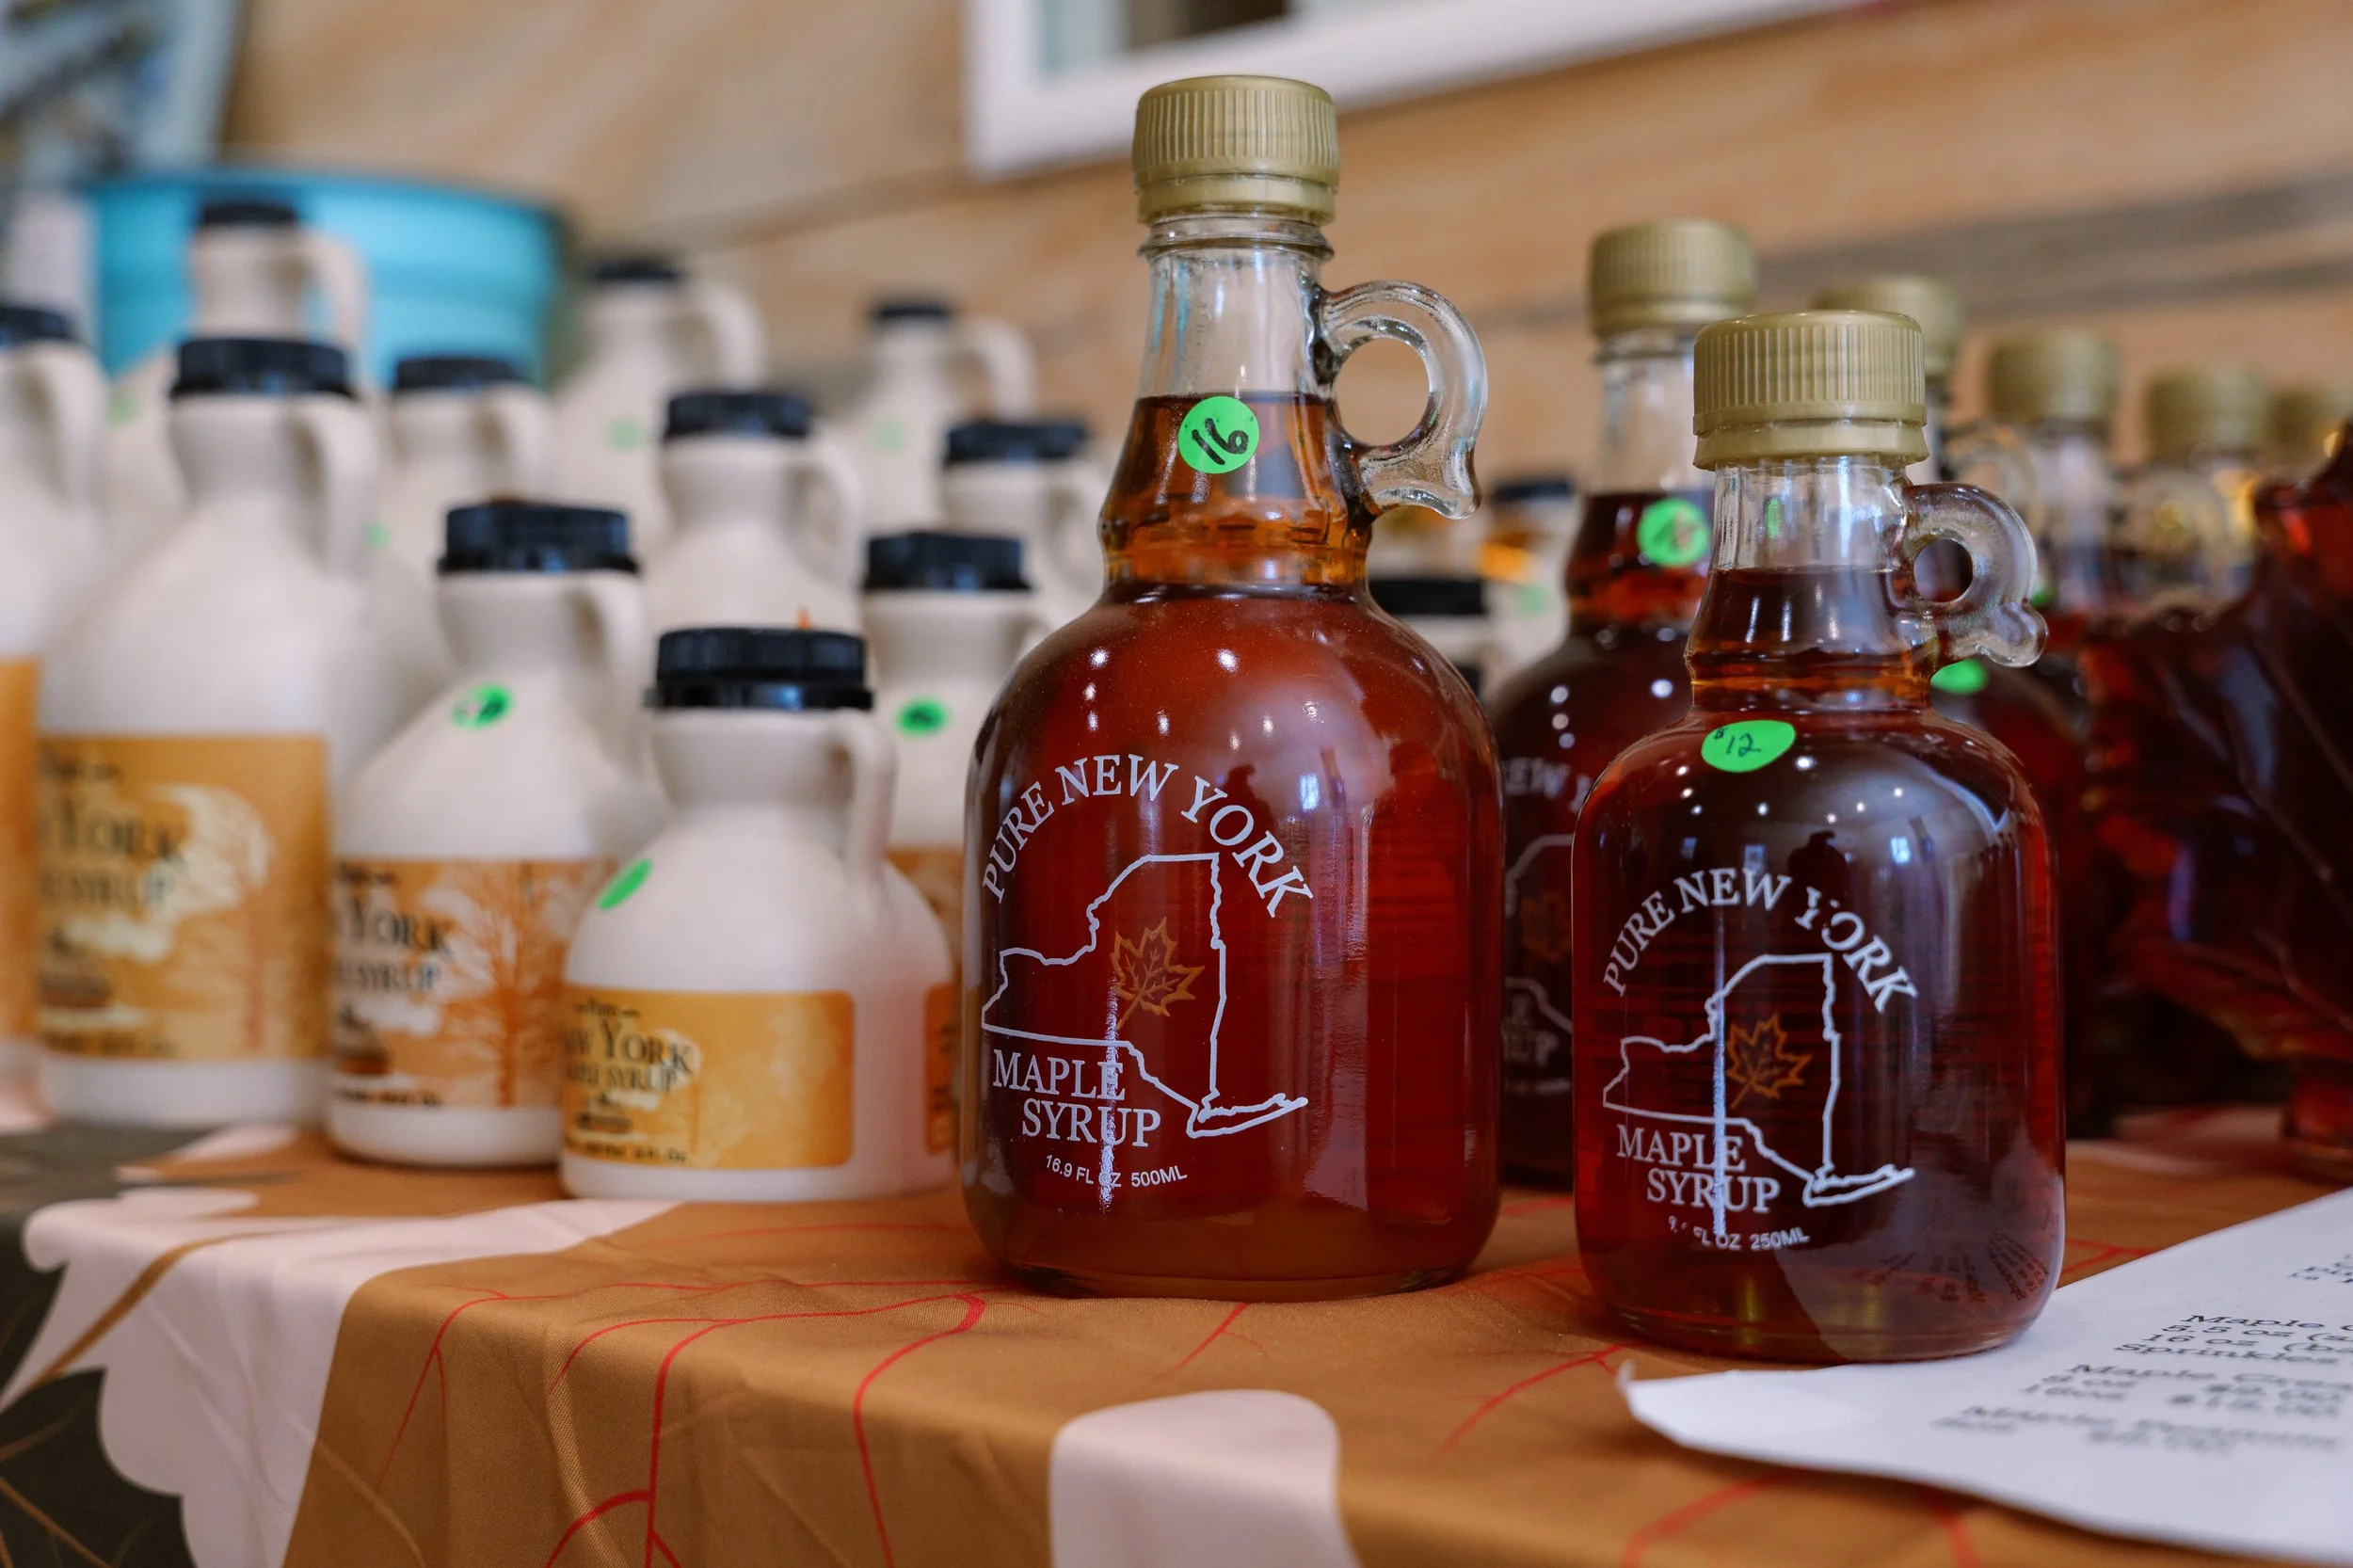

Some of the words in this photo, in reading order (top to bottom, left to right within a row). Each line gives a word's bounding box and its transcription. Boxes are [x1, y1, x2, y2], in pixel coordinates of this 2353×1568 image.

[1191, 418, 1249, 465] 16
[982, 782, 1055, 904] PURE
[1054, 753, 1178, 806] NEW
[1180, 776, 1314, 918] YORK
[1603, 891, 1675, 997] PURE
[1673, 867, 1792, 913] NEW
[1794, 887, 1917, 1013] YORK
[993, 1048, 1126, 1101] MAPLE
[1022, 1097, 1160, 1147] SYRUP
[1616, 1124, 1746, 1172] MAPLE
[1046, 1154, 1073, 1177] 16.9
[1076, 1166, 1094, 1184] FL
[1131, 1165, 1188, 1188] 500ML
[1646, 1168, 1780, 1213] SYRUP
[1715, 1232, 1741, 1250] OZ
[1749, 1225, 1811, 1251] 250ML
[2142, 1334, 2195, 1343] 16
[2205, 1338, 2261, 1347] oz
[2162, 1323, 2232, 1334] 5.5
[2242, 1329, 2296, 1337] oz
[2181, 1314, 2325, 1328] Maple
[2113, 1343, 2339, 1365] Sprinkles
